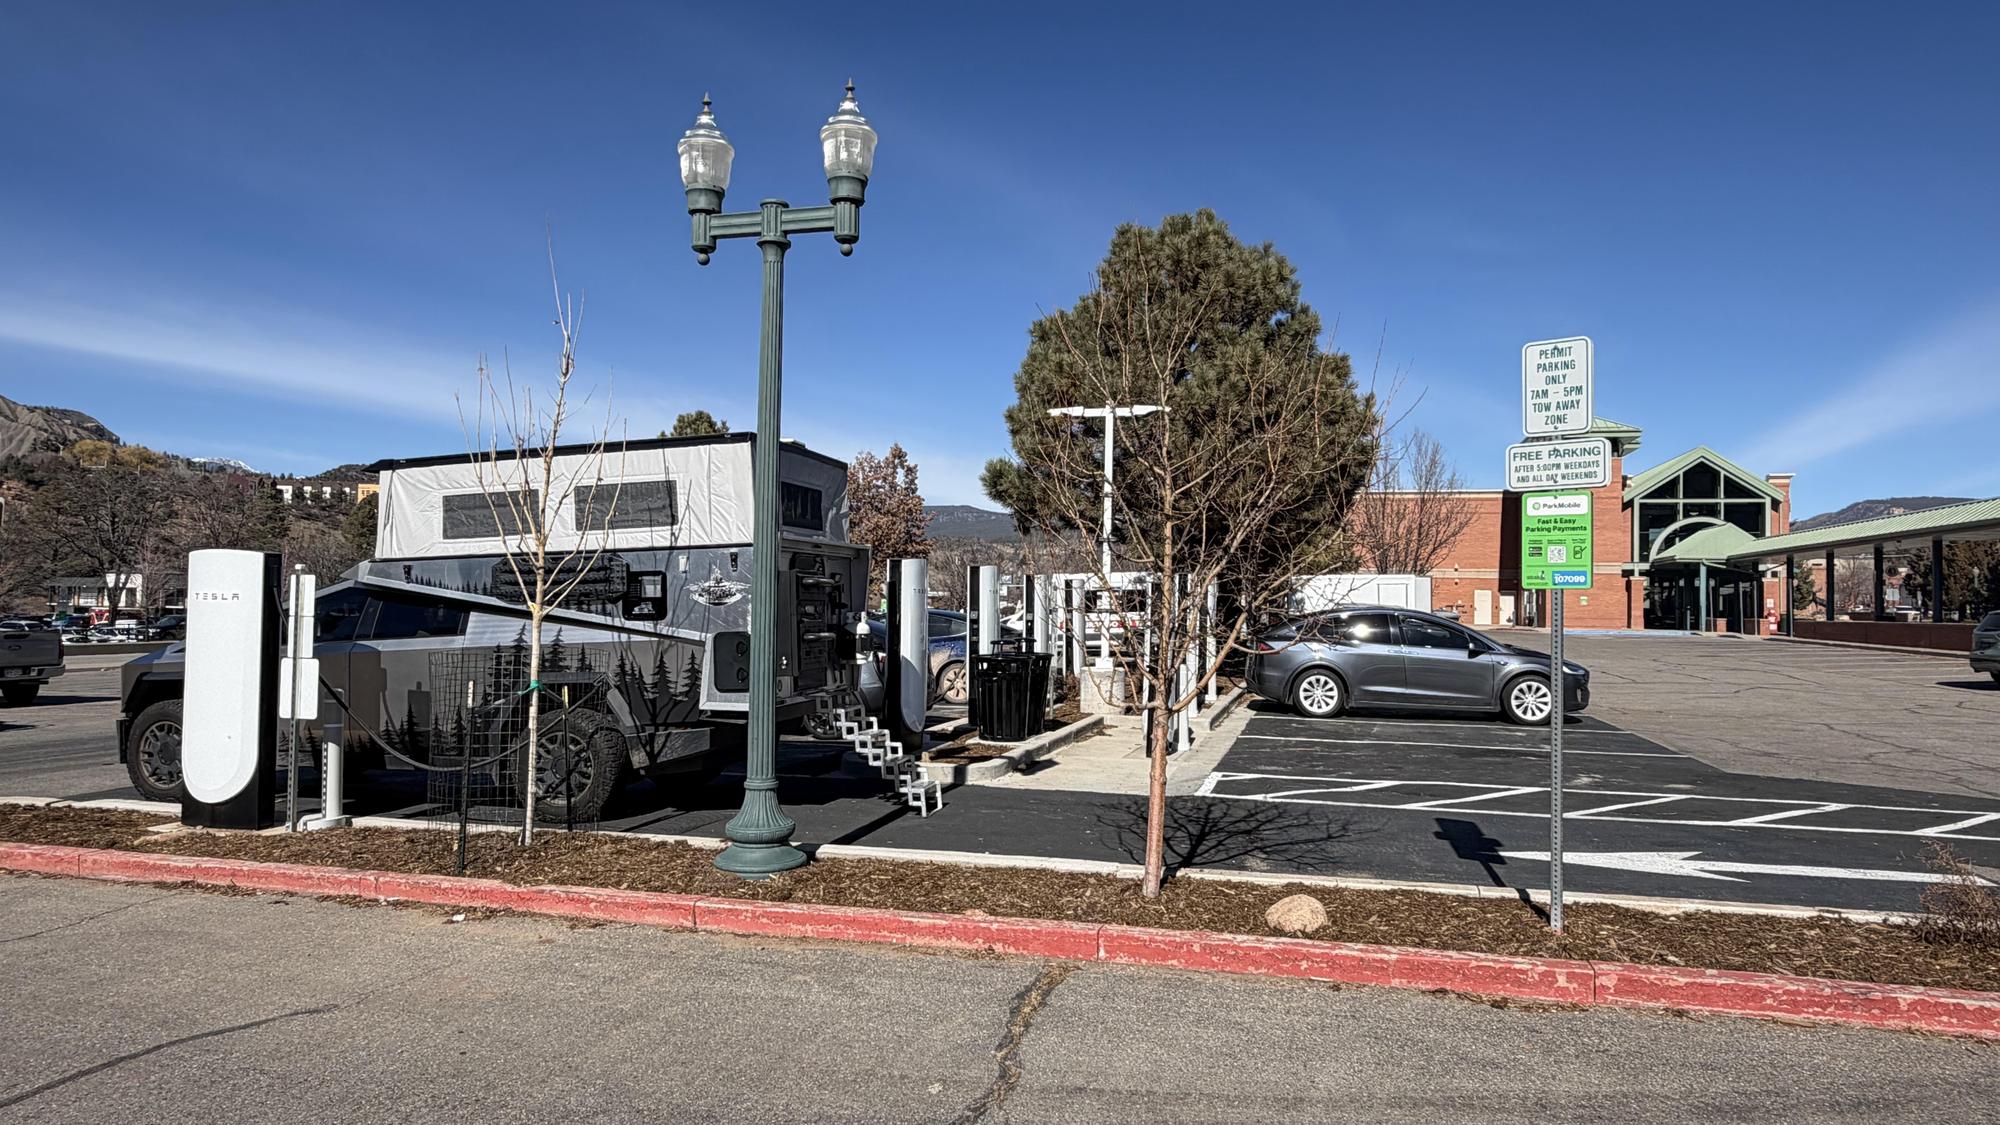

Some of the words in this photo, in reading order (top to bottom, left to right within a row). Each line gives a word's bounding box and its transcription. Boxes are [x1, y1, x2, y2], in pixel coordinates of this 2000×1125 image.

[1539, 346, 1573, 359] PERMIT
[1536, 360, 1576, 373] PARKING
[1545, 373, 1567, 386] ONLY
[1530, 388, 1549, 401] 7AM
[1563, 385, 1583, 397] 5PM
[1532, 401, 1552, 413] TOW
[1555, 399, 1581, 411] AWAY
[1544, 413, 1568, 426] ZONE
[1513, 450, 1543, 462] FREE
[1548, 446, 1601, 459] PARKING
[1514, 464, 1535, 473] AFTER
[1536, 462, 1562, 472] 5:00PM
[1563, 460, 1600, 470] WEEKDAYS
[1516, 475, 1530, 483] AND
[1532, 474, 1543, 482] ALL
[1546, 473, 1558, 482] DAY
[1560, 470, 1598, 481] WEEKENDS
[1559, 517, 1577, 525] Easy
[1552, 525, 1587, 533] Payments
[1554, 575, 1586, 584] 107099
[195, 592, 240, 601] TESLA
